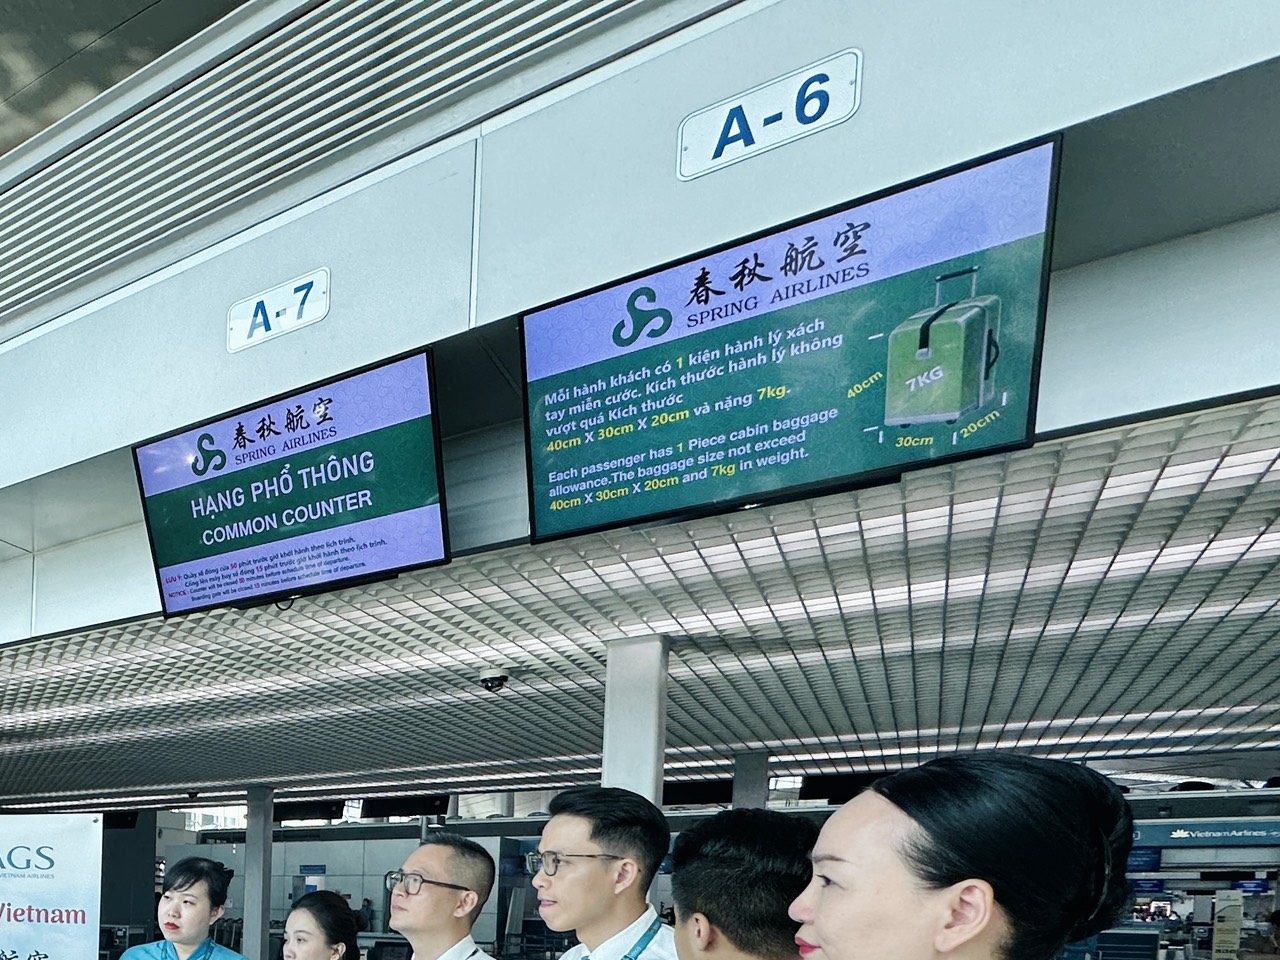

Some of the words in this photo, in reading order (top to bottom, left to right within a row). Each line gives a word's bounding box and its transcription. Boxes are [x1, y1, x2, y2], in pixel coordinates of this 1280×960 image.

[711, 72, 830, 160] A-6
[684, 222, 871, 308] 春秋航空
[246, 280, 314, 340] A-7
[687, 296, 758, 328] SPRING
[770, 262, 870, 305] AIRLINES
[544, 388, 570, 406] Mỗi
[573, 379, 607, 398] hành
[610, 367, 651, 387] khách
[655, 360, 671, 375] có
[676, 357, 683, 369] 1
[688, 350, 720, 366] kiện
[725, 335, 763, 357] hành
[768, 329, 783, 346] lý
[786, 318, 825, 339] xách
[545, 410, 565, 424] tay
[569, 397, 601, 416] miễn
[604, 388, 642, 406] cước.
[646, 376, 676, 395] Kích
[680, 364, 724, 386] thước
[729, 352, 767, 373] hành
[772, 347, 786, 363] lý
[790, 333, 843, 357] không
[846, 370, 883, 399] 40cm
[905, 365, 944, 392] 7KG
[232, 397, 334, 451] 春秋航空
[545, 421, 577, 437] vượt
[580, 412, 605, 430] quá
[608, 407, 638, 422] Kích
[641, 393, 684, 413] thước
[546, 437, 581, 452] 40cm
[584, 432, 594, 443] X
[597, 423, 634, 441] 30cm
[637, 418, 648, 430] X
[651, 409, 690, 427] 20cm
[693, 402, 710, 416] và
[714, 393, 753, 412] nặng
[757, 385, 791, 400] 7kg.
[895, 436, 934, 448] 30cm
[960, 409, 1001, 439] 20cm
[235, 444, 276, 465] SPRING
[282, 426, 337, 452] AIRLINES
[548, 468, 578, 483] Each
[581, 453, 646, 478] passenger
[649, 446, 673, 460] has
[677, 442, 683, 453] 1
[688, 434, 726, 451] Piece
[729, 423, 769, 442] cabin
[772, 408, 839, 432] baggage
[638, 457, 694, 478] baggage
[697, 450, 725, 465] size
[728, 443, 752, 458] not
[754, 430, 807, 452] exceed
[190, 487, 245, 519] HẠNG
[251, 463, 294, 502] PHỔ
[297, 451, 375, 489] THÔNG
[549, 497, 581, 511] 40cm
[584, 493, 594, 504] X
[595, 487, 629, 502] 30cm
[632, 482, 642, 493] X
[644, 475, 679, 492] 20cm
[682, 468, 708, 483] and
[711, 464, 735, 477] 7kg
[739, 459, 753, 471] in
[756, 447, 809, 468] weight.
[202, 513, 278, 546] COMMON
[282, 489, 373, 526] COUNTER
[340, 546, 356, 554] theo
[1189, 830, 1230, 838] Vietnam
[1230, 829, 1267, 837] Airlines
